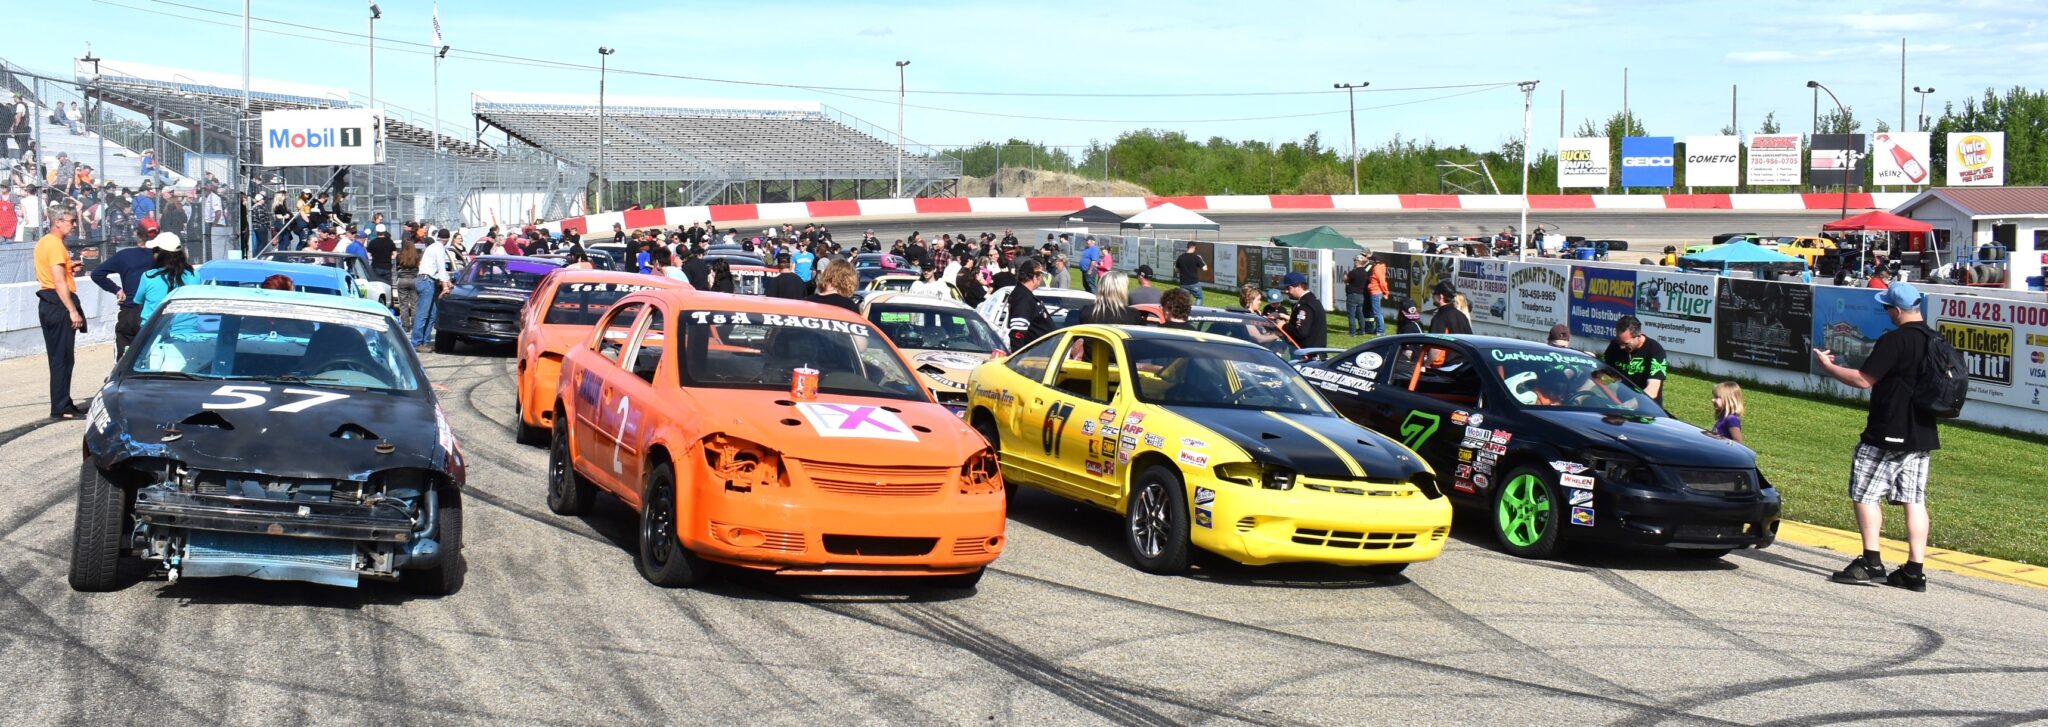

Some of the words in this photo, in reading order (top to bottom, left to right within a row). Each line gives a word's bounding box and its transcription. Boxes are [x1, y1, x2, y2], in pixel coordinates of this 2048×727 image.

[269, 128, 335, 148] Mobil
[343, 128, 358, 147] 1
[1560, 150, 1591, 161] BUCKS
[1622, 156, 1674, 167] GEICO
[1688, 155, 1737, 163] COMETIC
[1566, 160, 1593, 169] AUTO
[1879, 170, 1901, 178] HEINZ
[1386, 266, 1409, 280] STVIEW
[1511, 266, 1547, 288] STEWART'S
[1548, 269, 1565, 292] TIRE
[1458, 279, 1478, 290] CAMARO
[1484, 281, 1507, 293] FIREBIRD
[1588, 277, 1609, 296] AUTO
[1609, 279, 1634, 298] PARTS
[1657, 278, 1709, 296] Pipestone
[1518, 288, 1556, 301] 780-450-9965
[1521, 301, 1552, 313] Treadpro.ca
[1572, 305, 1589, 318] Allied
[1667, 291, 1712, 319] Flyer
[1941, 299, 2048, 326] 780.428.1000
[762, 313, 870, 337] RACING
[1581, 323, 1616, 337] 780-352-716
[1644, 320, 1701, 335] www.pipestoneflyer.ca
[1939, 324, 1956, 346] Got
[1958, 332, 1965, 348] a
[1966, 328, 2009, 354] Ticket?
[1492, 349, 1551, 362] Carbone
[1550, 352, 1597, 369] Racing
[1350, 365, 1377, 379] FREEDOM
[1985, 354, 2004, 379] it!
[2030, 368, 2046, 378] VISA
[202, 385, 350, 413] 57
[614, 395, 629, 474] 2
[1042, 400, 1076, 459] 67
[1101, 425, 1119, 434] PFC
[1123, 424, 1143, 434] ARP
[1401, 409, 1440, 452] 7
[1467, 427, 1483, 437] Mobil
[1482, 442, 1505, 453] ARP
[1181, 450, 1208, 464] WHELEN
[1458, 451, 1472, 461] OMP
[1564, 475, 1592, 485] WHELEN
